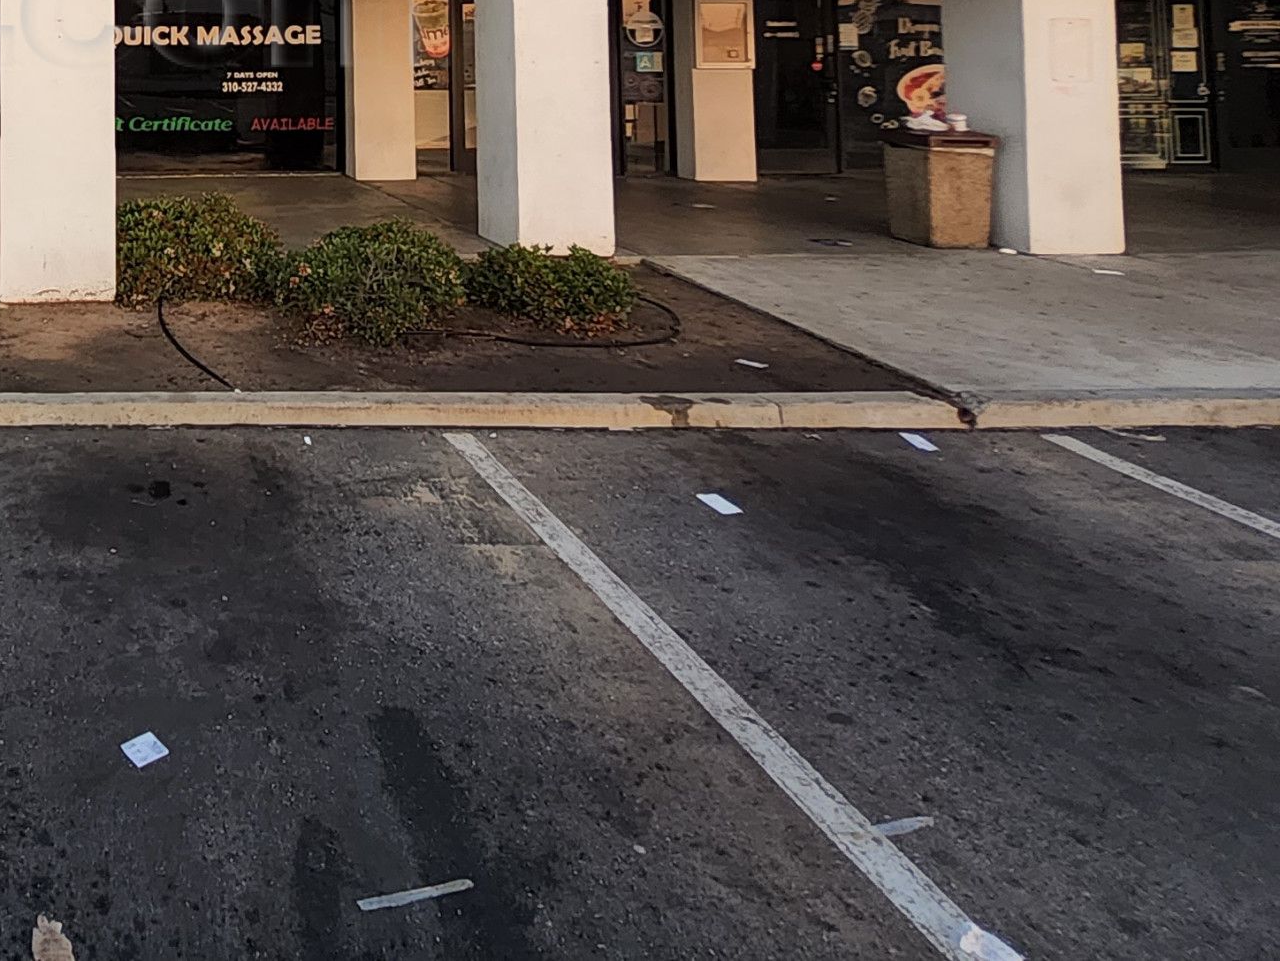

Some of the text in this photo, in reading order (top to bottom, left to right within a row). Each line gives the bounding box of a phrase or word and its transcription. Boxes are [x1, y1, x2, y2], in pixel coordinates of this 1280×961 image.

[196, 24, 322, 46] MASSAGE
[226, 72, 232, 80] 7
[222, 81, 283, 93] 310-527-4332
[123, 116, 233, 132] Certificate
[250, 116, 335, 131] AVAILABLE
